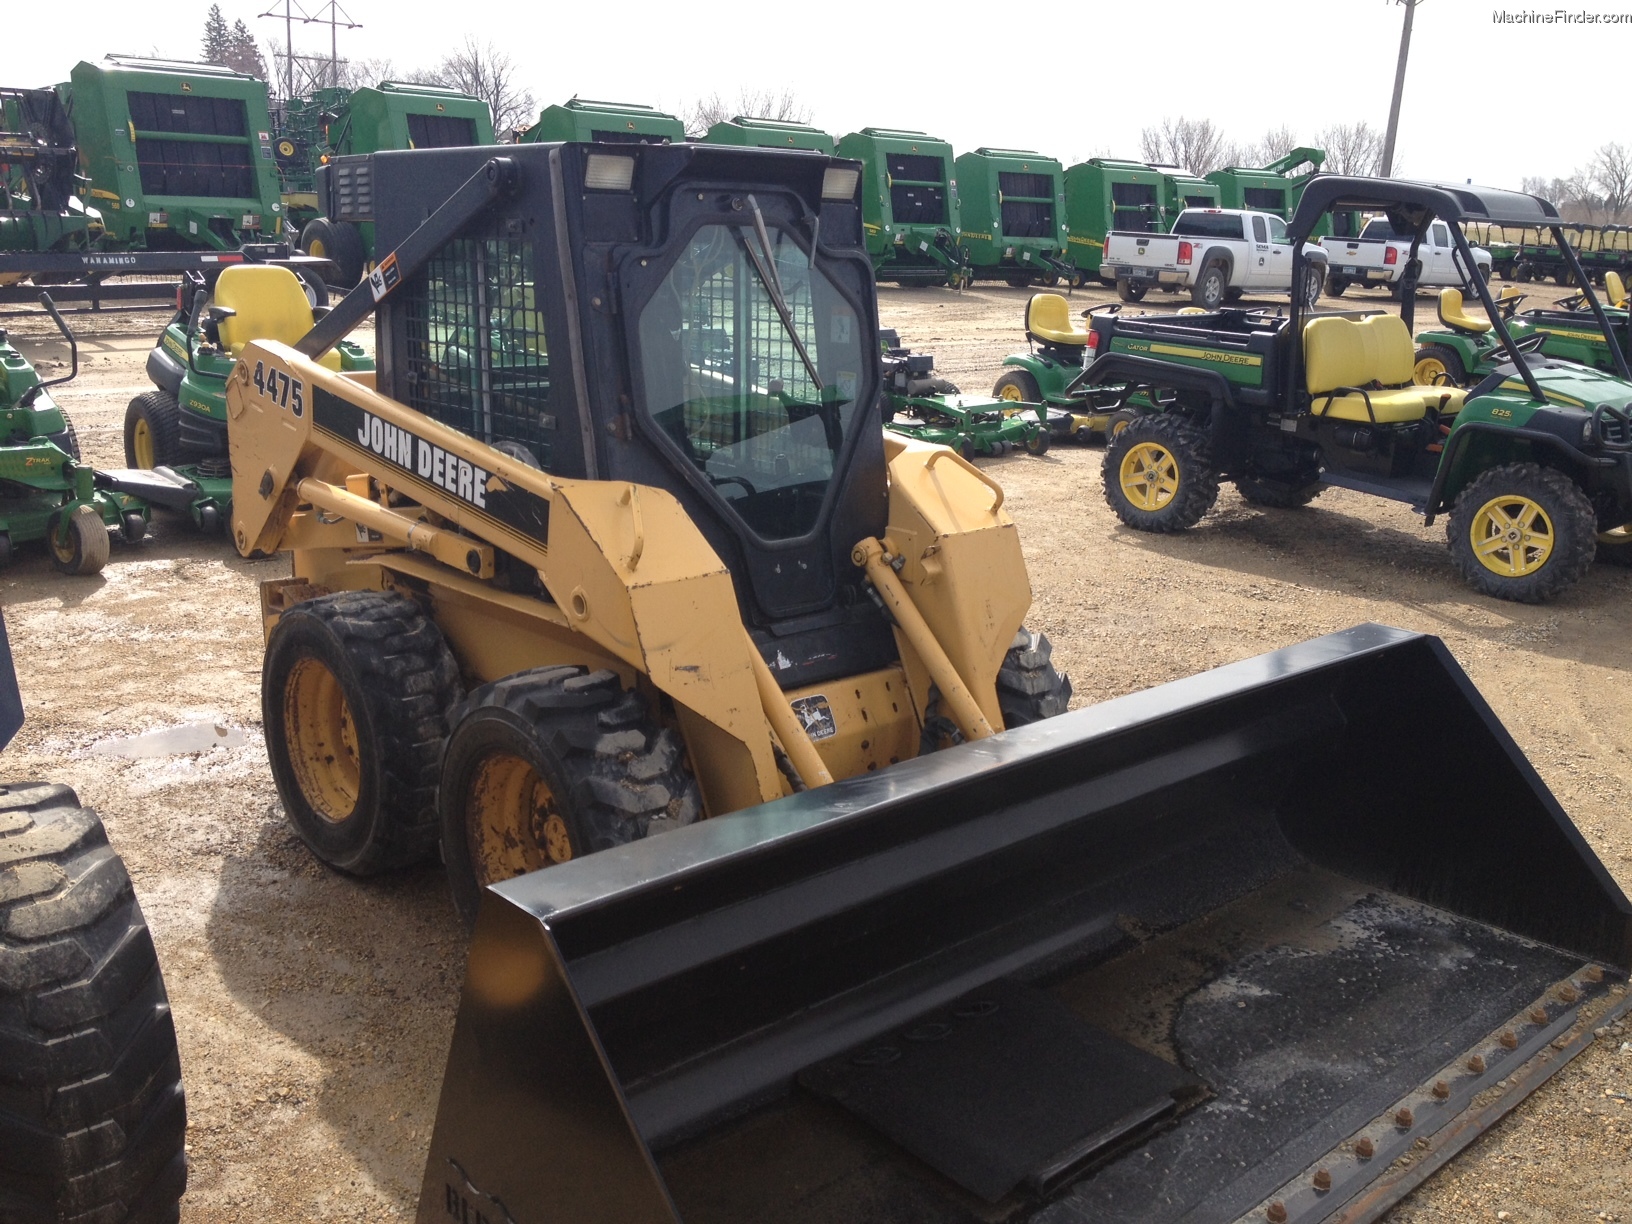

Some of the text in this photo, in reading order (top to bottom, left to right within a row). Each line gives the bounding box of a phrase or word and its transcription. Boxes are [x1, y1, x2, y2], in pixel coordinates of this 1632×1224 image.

[82, 256, 136, 265] WANAMINGO
[1201, 352, 1250, 364] JOHN DEERE
[253, 360, 304, 418] 4475
[189, 400, 211, 412] Z930A
[357, 412, 487, 509] JOHN DEERE
[817, 726, 834, 737] DEERE
